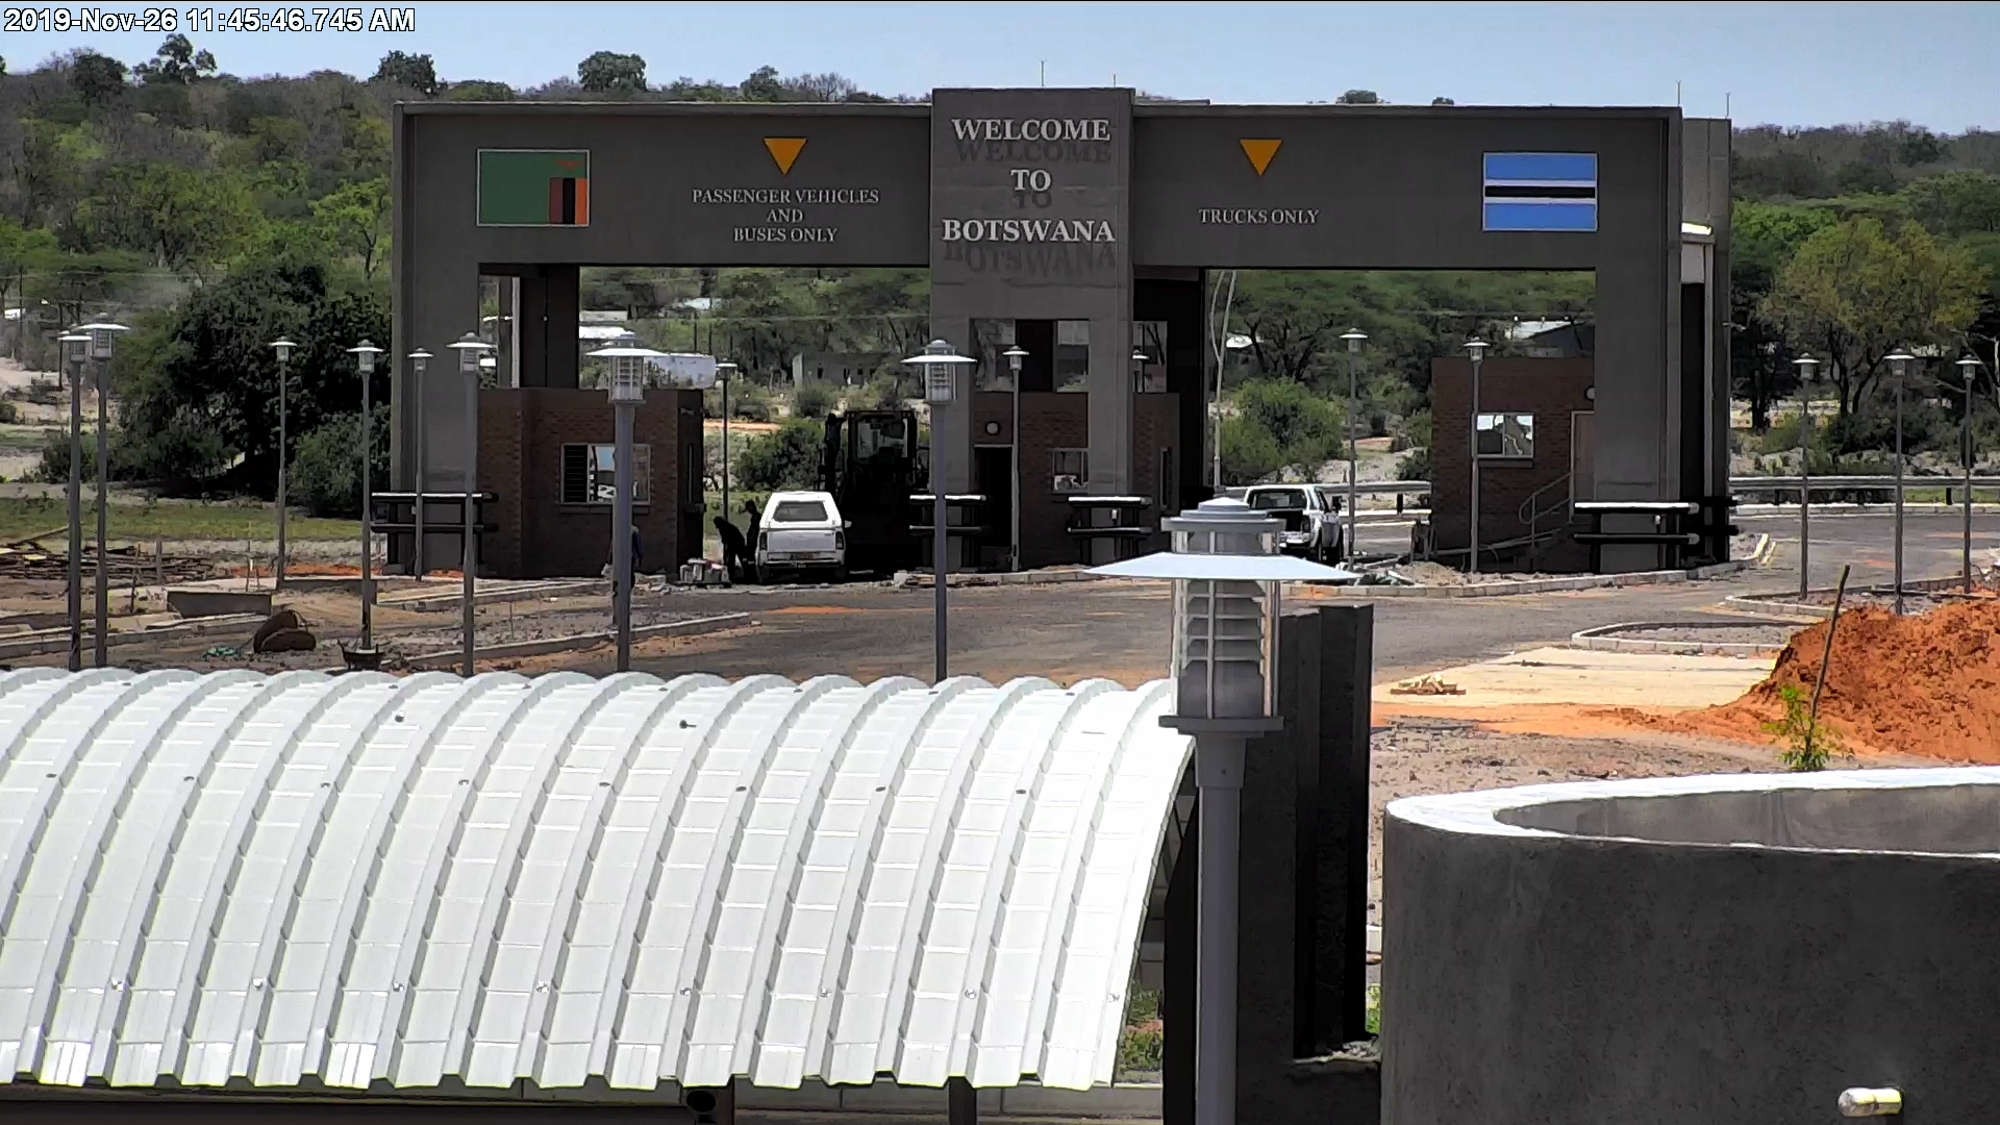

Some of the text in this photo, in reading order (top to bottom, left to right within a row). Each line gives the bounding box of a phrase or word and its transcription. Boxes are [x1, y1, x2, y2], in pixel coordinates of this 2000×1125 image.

[951, 118, 1111, 142] WELCOME
[1010, 169, 1051, 192] TO
[692, 189, 879, 203] PASSENGER VEHICLES
[767, 209, 803, 223] AND
[1199, 208, 1319, 224] TRUCKS ONLY
[734, 228, 838, 242] BUSES ONLY
[942, 219, 1116, 243] BOTSWANA
